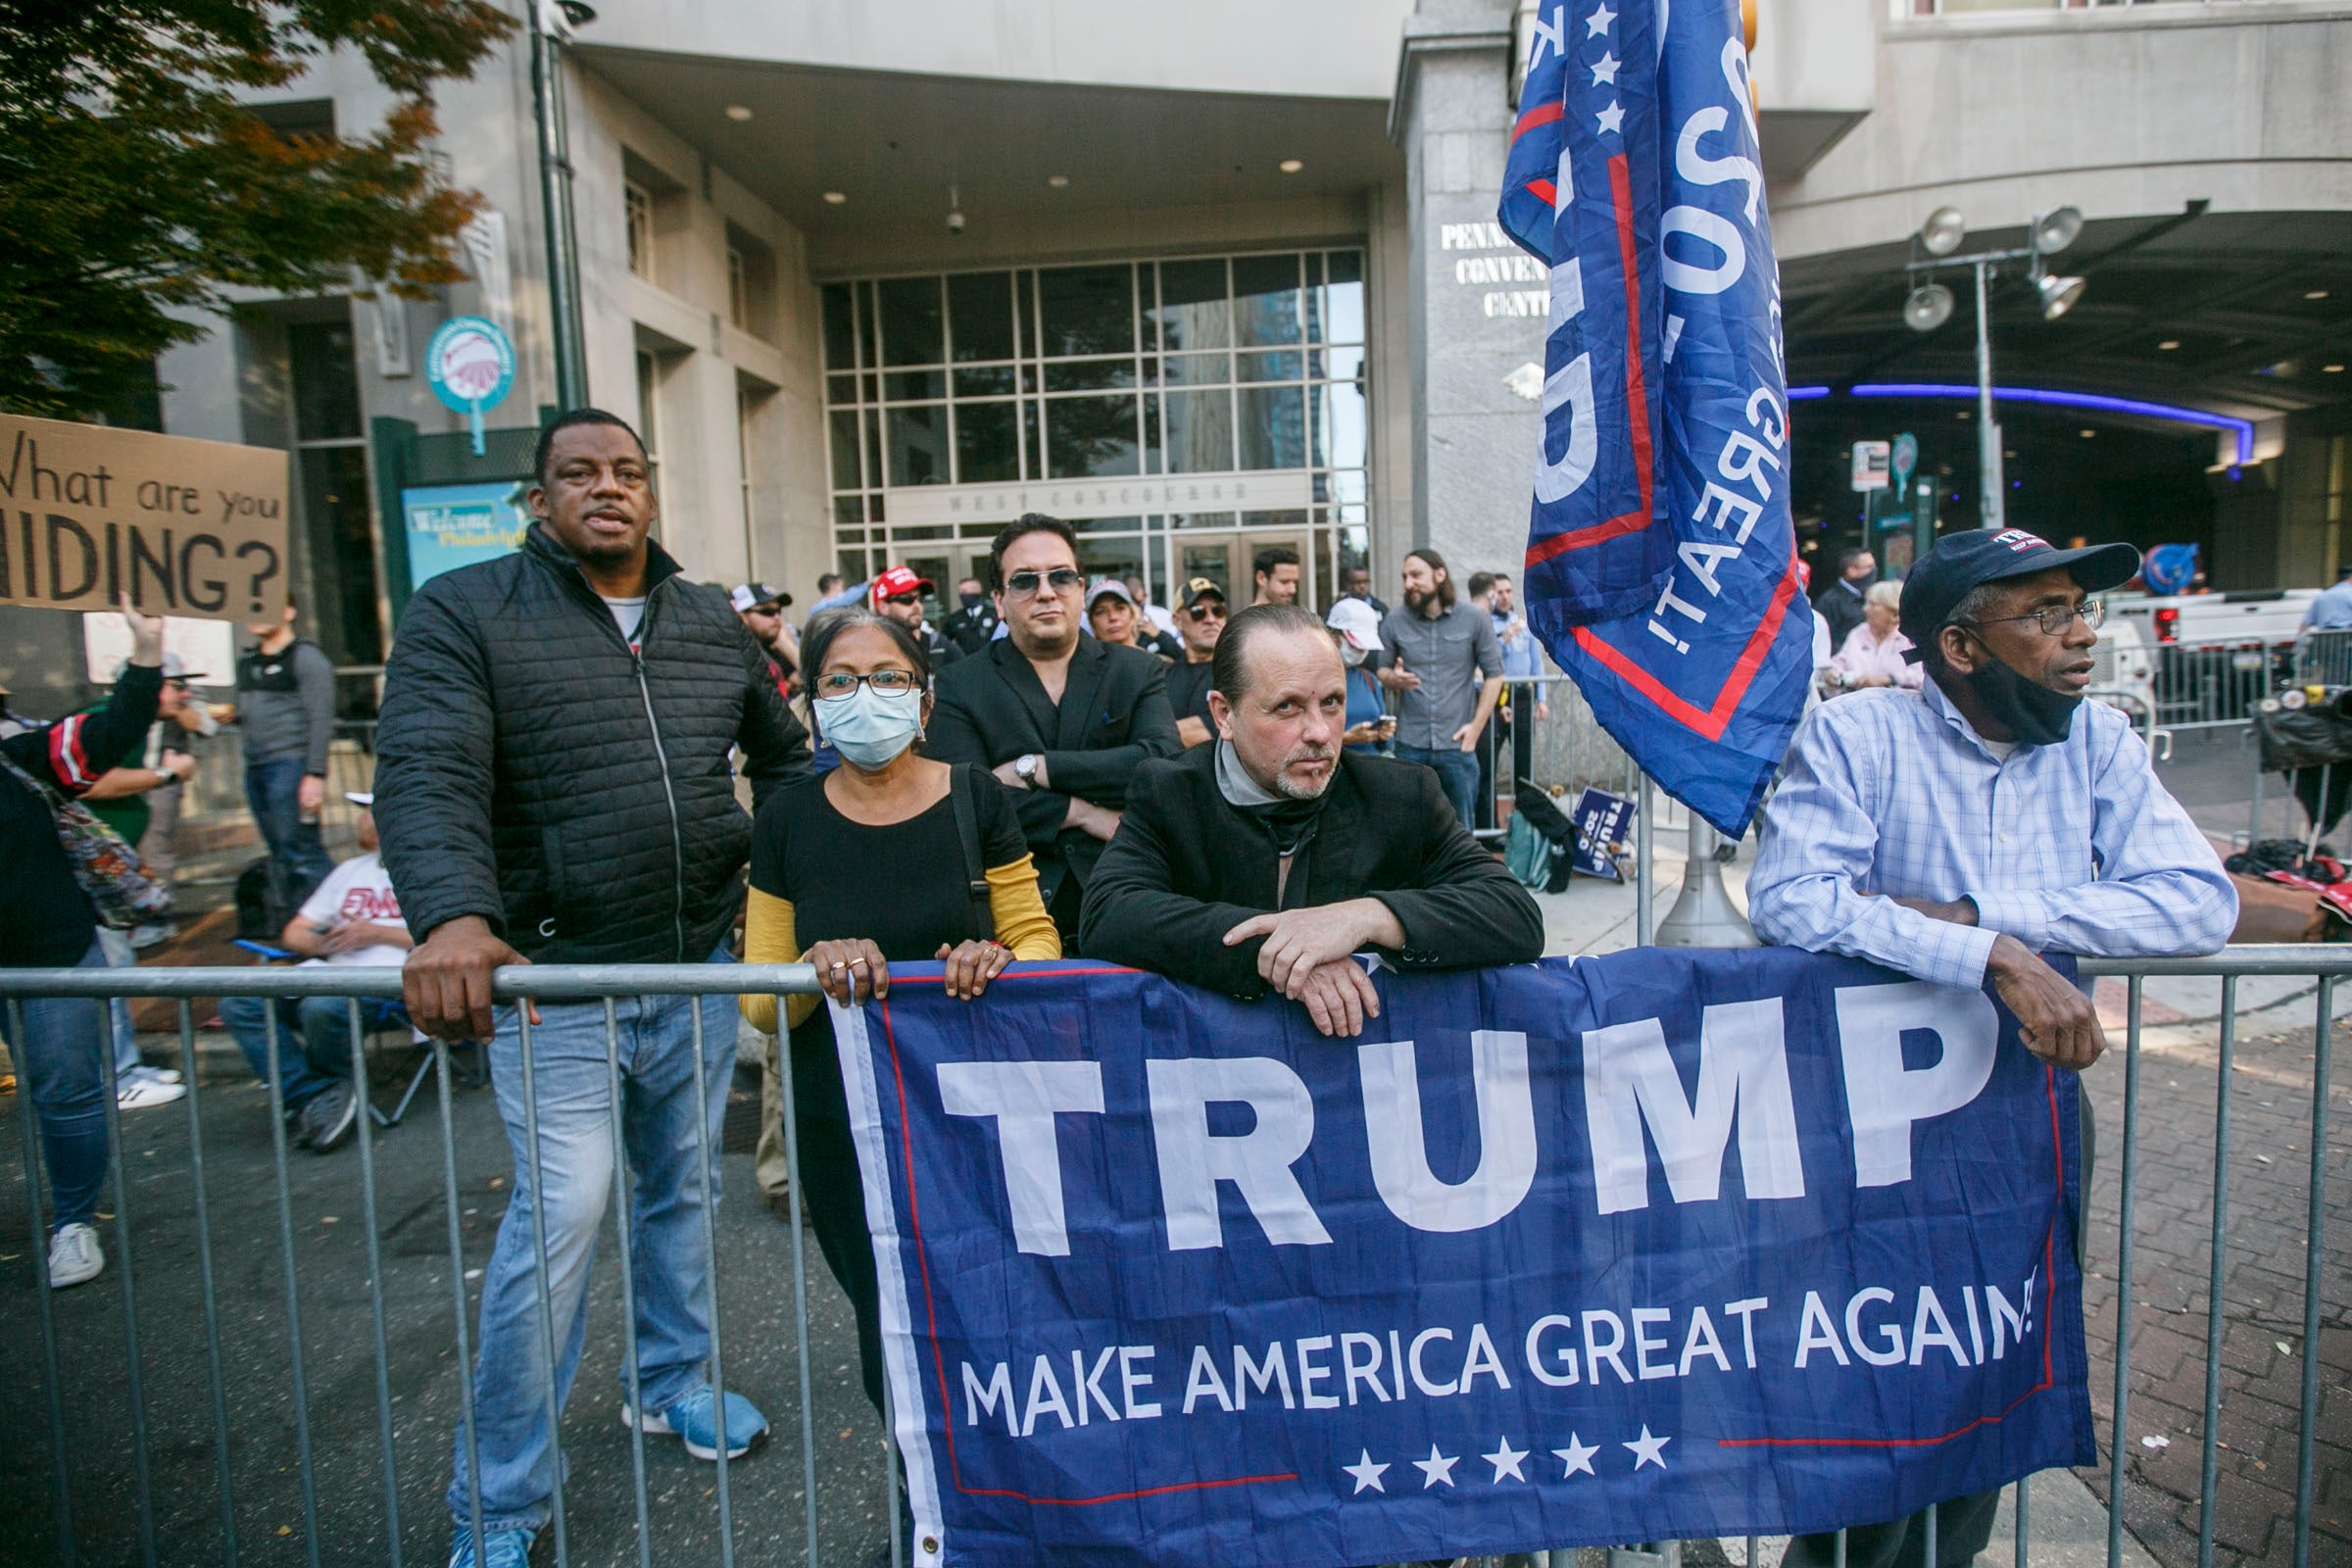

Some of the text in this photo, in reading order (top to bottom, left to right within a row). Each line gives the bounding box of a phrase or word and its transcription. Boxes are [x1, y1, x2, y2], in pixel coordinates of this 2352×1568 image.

[1442, 222, 1515, 250] PENN
[1455, 256, 1545, 284] CONVEN
[1484, 290, 1550, 318] CENT
[137, 480, 201, 515] are
[218, 490, 280, 523] you
[950, 483, 1246, 512] WEST CONCOURSE
[0, 508, 279, 612] IDING?
[937, 983, 1996, 1256] TRUMP
[960, 1264, 2038, 1437] MAKE AMERICA GREAT AGAIN!
